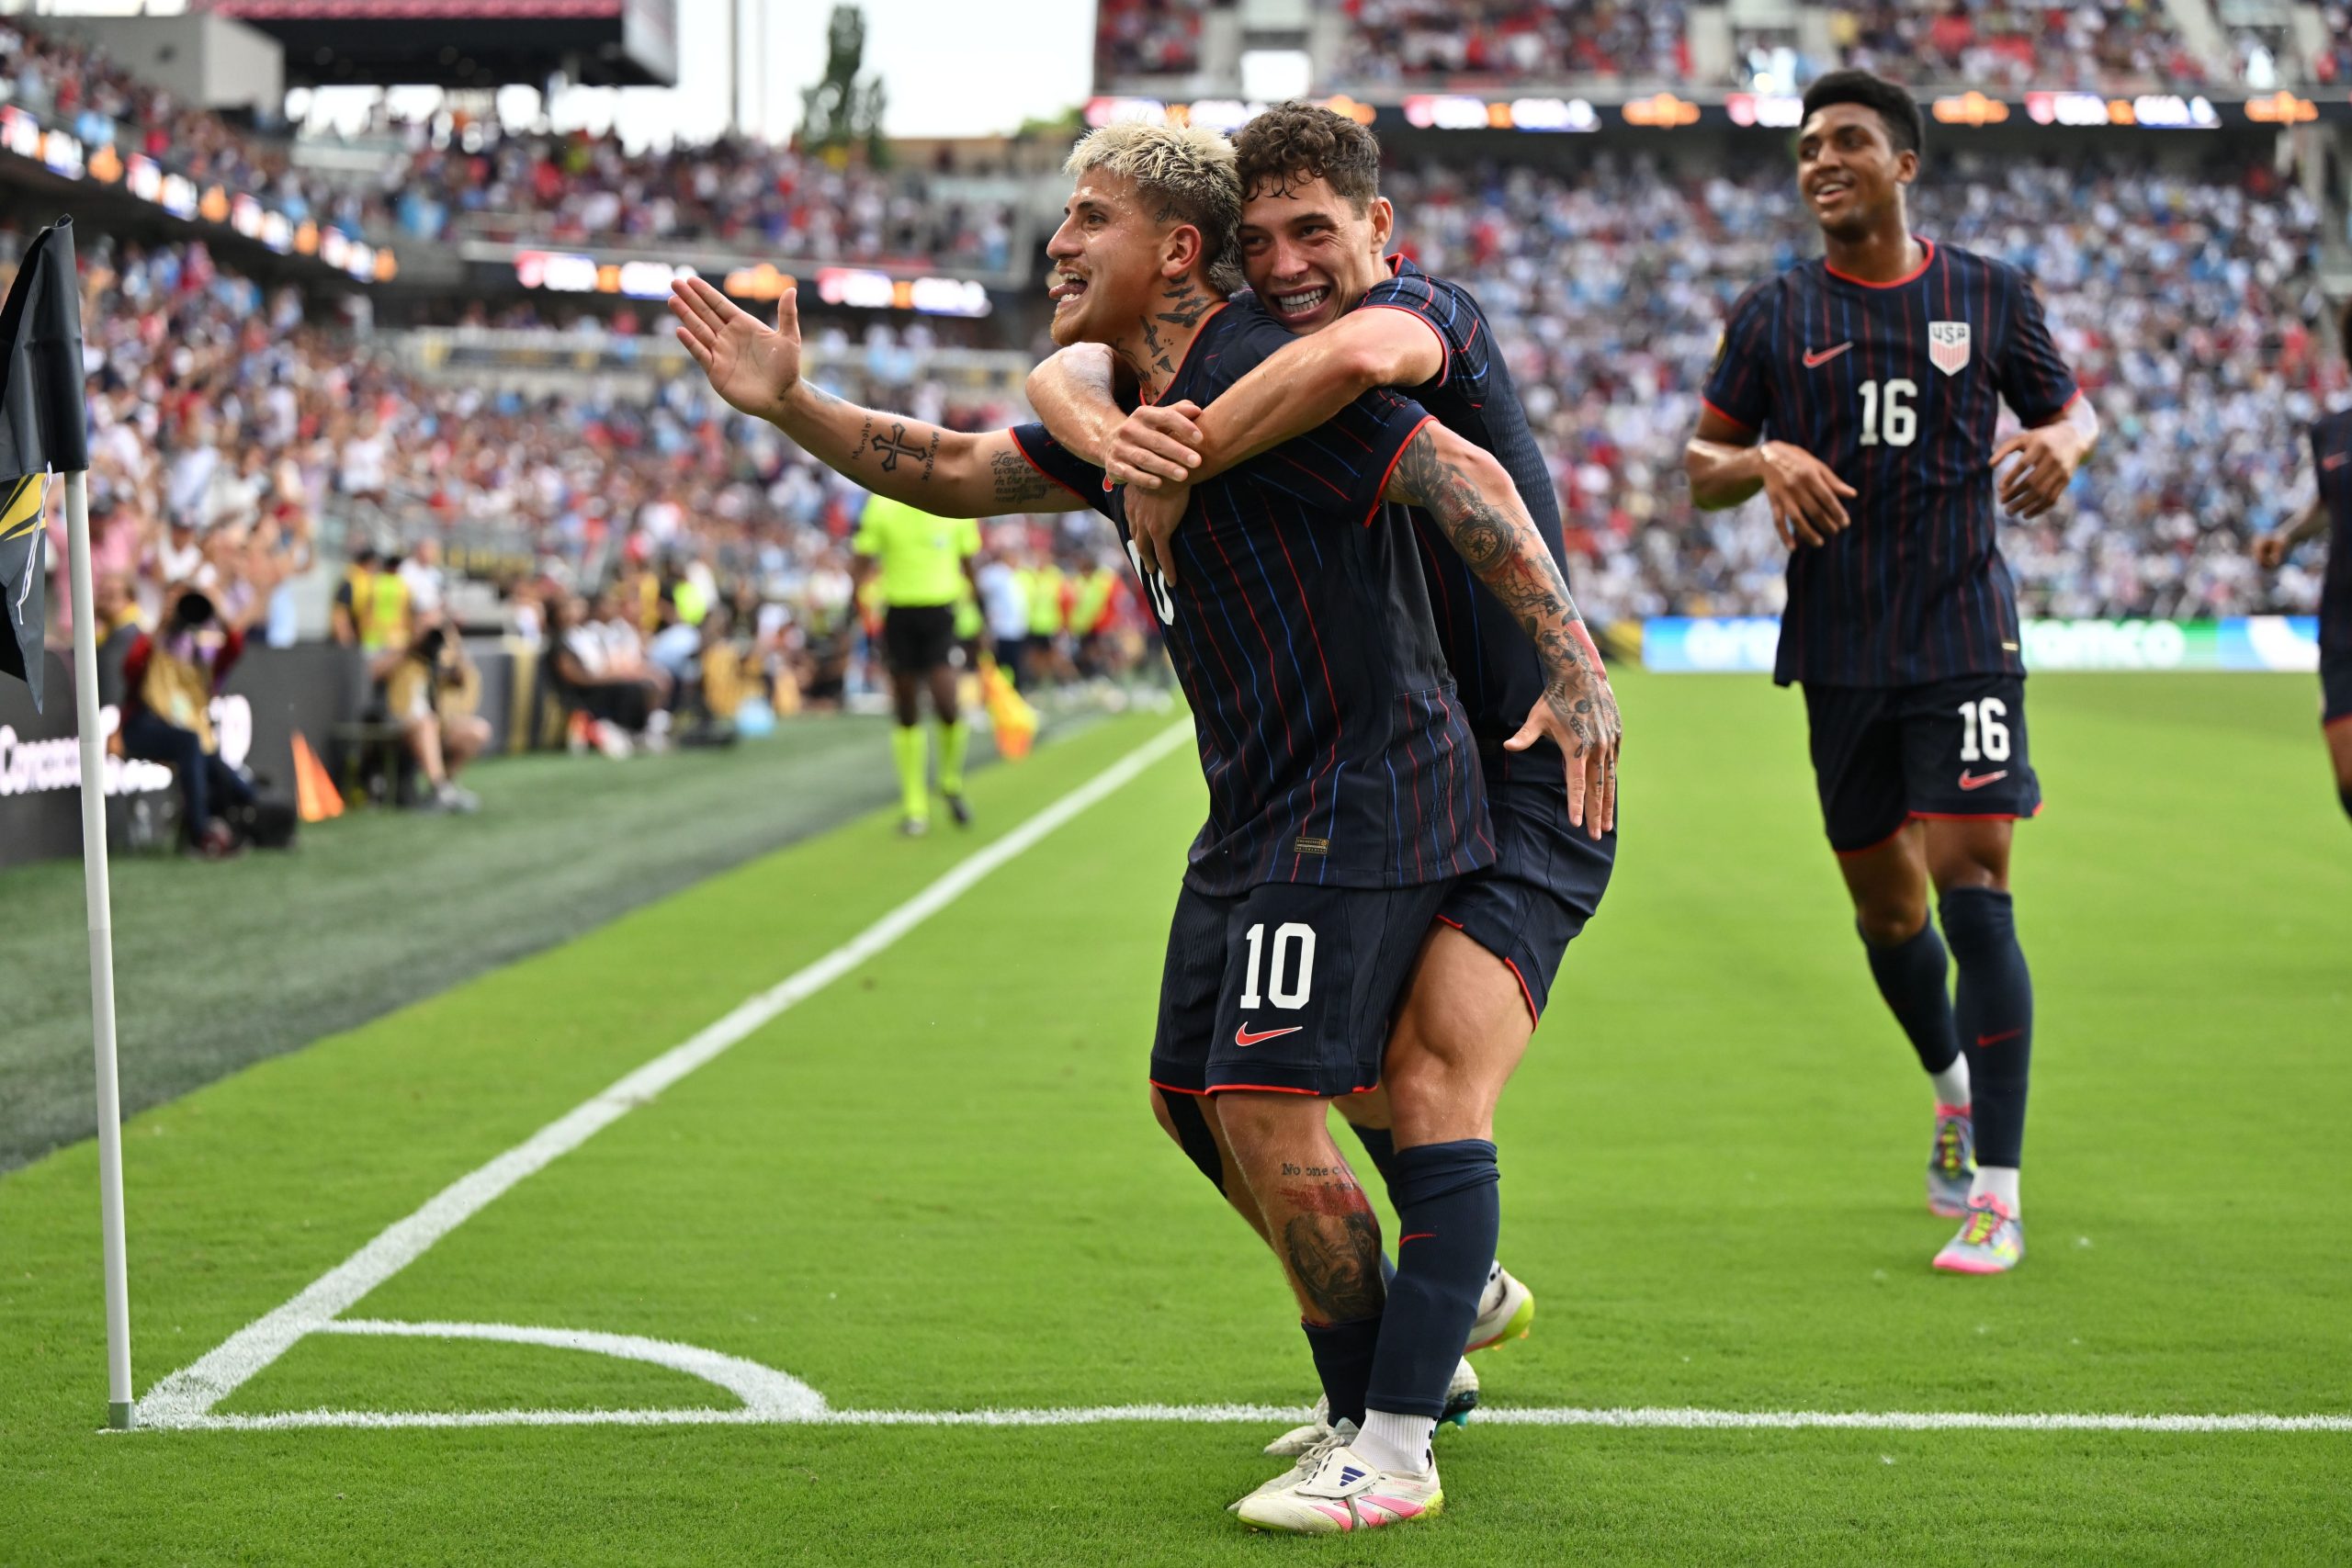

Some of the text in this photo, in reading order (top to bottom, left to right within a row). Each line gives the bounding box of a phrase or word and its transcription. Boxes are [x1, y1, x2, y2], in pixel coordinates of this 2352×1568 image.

[1932, 326, 1966, 344] USA
[1858, 378, 1918, 446] 16
[1958, 697, 2011, 761] 16
[1239, 922, 1317, 1010] 10
[1283, 1163, 1301, 1176] No
[1306, 1168, 1329, 1177] one
